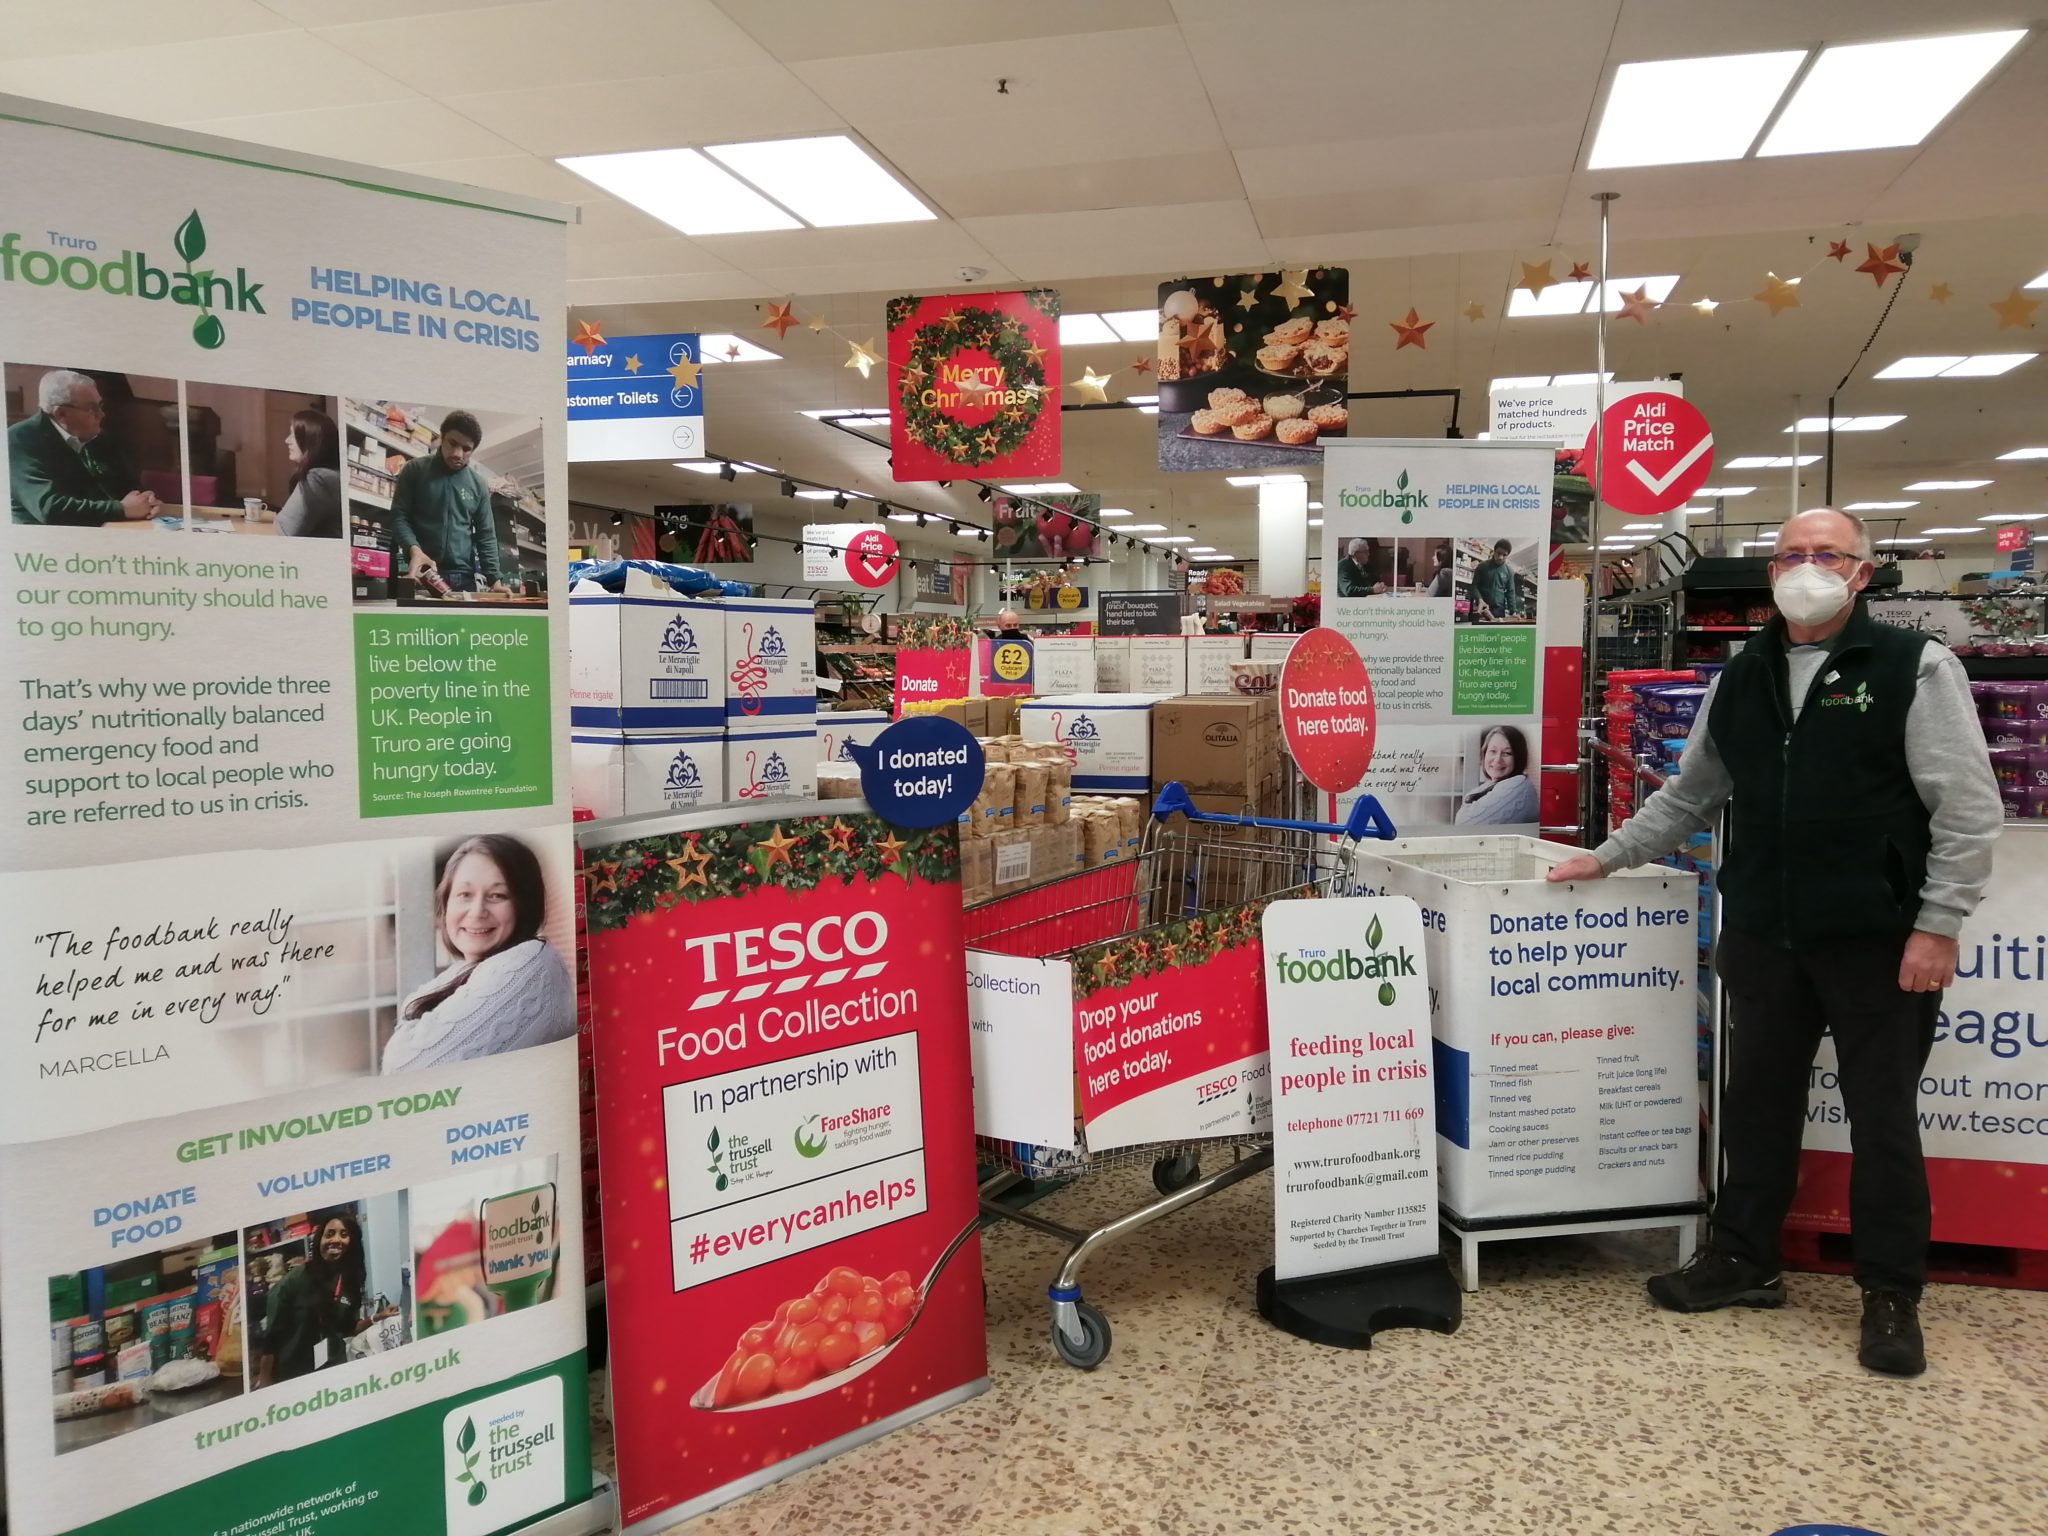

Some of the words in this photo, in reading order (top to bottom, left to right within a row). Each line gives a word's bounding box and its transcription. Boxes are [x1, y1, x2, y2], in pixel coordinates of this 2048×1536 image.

[48, 231, 97, 251] Truro
[0, 232, 266, 315] foodbank
[310, 266, 442, 307] HELPING
[449, 288, 539, 321] LOCAL
[291, 299, 410, 336] PEOPLE
[418, 315, 448, 338] IN
[453, 320, 539, 352] CRISIS
[568, 354, 612, 367] armacy
[943, 365, 1005, 386] Merry
[567, 395, 614, 406] stomer
[617, 392, 658, 405] Toilets
[921, 389, 1028, 408] Chrmas
[1498, 399, 1526, 407] We've
[1529, 398, 1553, 408] price
[1634, 403, 1665, 417] Aldi
[1498, 409, 1539, 419] matched
[1542, 407, 1587, 417] hundreds
[1498, 421, 1507, 429] of
[1509, 420, 1555, 431] products.
[1624, 420, 1674, 436] Price
[1624, 437, 1674, 451] Match
[1338, 489, 1428, 508] foodbank
[1447, 484, 1499, 495] HELPING
[1502, 485, 1540, 495] LOCAL
[1438, 499, 1484, 509] PEOPLE
[1487, 499, 1499, 509] IN
[1503, 499, 1540, 509] CRISIS
[1188, 570, 1208, 578] Ready
[659, 655, 666, 664] Le
[668, 655, 700, 666] Meraviglie
[1002, 649, 1022, 664] £2
[666, 665, 672, 674] di
[674, 665, 694, 675] Napoli
[901, 676, 938, 692] Donate
[1288, 688, 1336, 708] Donate
[1339, 686, 1367, 705] food
[1822, 694, 1874, 707] foodbank
[1297, 715, 1328, 736] here
[1331, 714, 1368, 736] today.
[1997, 735, 2024, 744] Quality
[879, 750, 883, 770] I
[890, 746, 967, 769] donated
[372, 791, 403, 801] Source:
[406, 790, 420, 799] The
[422, 787, 449, 801] Joseph
[451, 786, 492, 798] Rowntree
[495, 784, 537, 795] Foundation
[894, 774, 953, 798] today!
[1490, 913, 1568, 935] Donate
[1574, 907, 1628, 929] food
[1637, 907, 1689, 927] here
[685, 911, 888, 983] TESCO
[1299, 949, 1326, 958] Truro
[1490, 948, 1512, 966] to
[1518, 941, 1567, 966] help
[1574, 940, 1627, 966] your
[1277, 946, 1417, 984] foodbank
[966, 970, 1040, 995] Collection
[1490, 972, 1540, 996] local
[1548, 966, 1684, 994] community.
[1080, 1006, 1115, 1033] Drop
[1119, 991, 1158, 1023] your
[657, 1014, 746, 1066] Food
[758, 988, 917, 1043] Collection
[972, 1020, 992, 1032] with
[1084, 1036, 1116, 1065] food
[1120, 1010, 1202, 1049] donations
[1491, 1033, 1500, 1046] If
[1505, 1034, 1528, 1048] you
[1532, 1031, 1557, 1044] can,
[1561, 1027, 1603, 1043] please
[1607, 1024, 1634, 1041] give:
[1290, 1035, 1363, 1058] feeding
[1369, 1029, 1414, 1051] local
[40, 1045, 170, 1079] MARCELLA
[1089, 1067, 1119, 1097] here
[1123, 1049, 1172, 1078] today.
[1490, 1064, 1516, 1073] Tinned
[1519, 1063, 1538, 1071] meat
[693, 1090, 713, 1114] In
[722, 1059, 848, 1111] partnership
[855, 1047, 897, 1075] with
[1196, 1075, 1237, 1098] TESCO
[1242, 1067, 1265, 1083] Food
[1281, 1067, 1345, 1096] people
[1352, 1064, 1370, 1083] in
[1378, 1060, 1427, 1081] crisis
[1490, 1095, 1516, 1103] Tinned
[1518, 1094, 1531, 1103] veg
[821, 1105, 891, 1133] FareShare
[1288, 1116, 1343, 1133] telephone
[1347, 1112, 1379, 1126] 07721
[1383, 1110, 1400, 1122] 711
[1405, 1108, 1424, 1120] 669
[1490, 1110, 1516, 1118] Instant
[1519, 1108, 1548, 1117] mashed
[1551, 1106, 1576, 1116] potato
[176, 1132, 233, 1164] GET
[239, 1105, 373, 1150] INVOLVED
[377, 1086, 462, 1122] TODAY
[446, 1113, 529, 1145] DONATE
[843, 1125, 867, 1138] fighting
[868, 1120, 891, 1133] hunger,
[1489, 1124, 1520, 1134] Cooking
[1523, 1123, 1549, 1131] sauces
[450, 1135, 526, 1165] MONEY
[728, 1135, 748, 1149] the
[729, 1139, 772, 1161] trussell
[835, 1136, 857, 1150] tackling
[859, 1133, 873, 1144] food
[875, 1129, 891, 1141] waste
[730, 1157, 757, 1174] trust
[1294, 1148, 1420, 1170] www.trurofoodbank.org
[257, 1154, 391, 1198] VOLUNTEER
[1286, 1169, 1428, 1193] trurofoodbank@gmail.com
[93, 1186, 196, 1227] DONATE
[1291, 1217, 1331, 1229] Registered
[1333, 1212, 1362, 1224] Charity
[1364, 1209, 1395, 1220] Number
[1397, 1204, 1426, 1215] 1135825
[111, 1215, 182, 1248] FOOD
[489, 1211, 550, 1241] foodbank
[690, 1177, 916, 1265] #everycanhelps
[195, 1348, 462, 1450] truro.foodbank.org.uk
[489, 1412, 512, 1428] seeded
[514, 1409, 525, 1421] by
[489, 1420, 520, 1444] the
[489, 1423, 555, 1462] trussell
[489, 1449, 533, 1479] trust
[296, 1487, 342, 1511] network
[344, 1481, 357, 1494] of
[287, 1511, 318, 1529] Trust,
[320, 1495, 365, 1517] working
[367, 1489, 378, 1500] to
